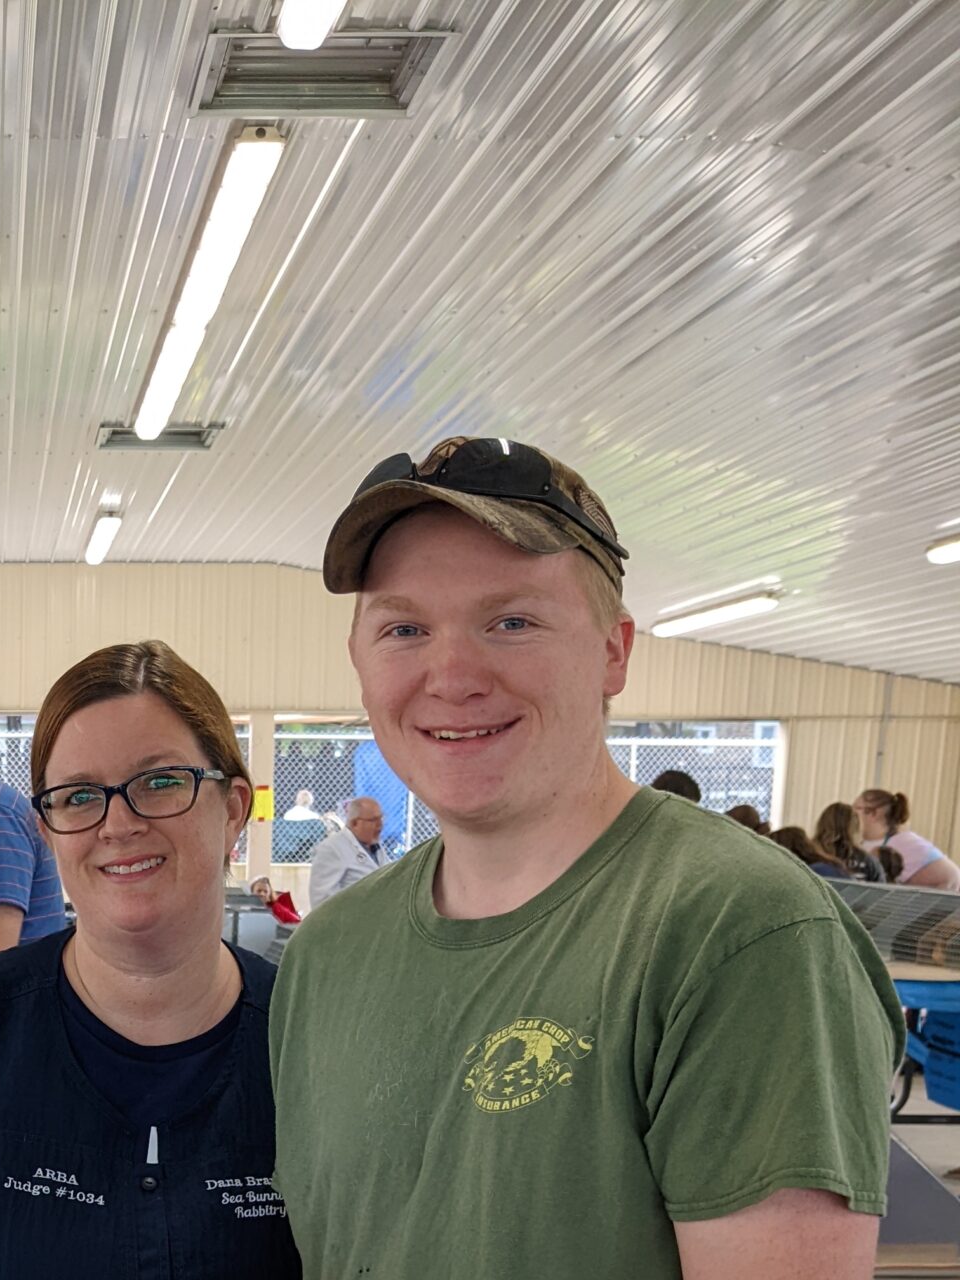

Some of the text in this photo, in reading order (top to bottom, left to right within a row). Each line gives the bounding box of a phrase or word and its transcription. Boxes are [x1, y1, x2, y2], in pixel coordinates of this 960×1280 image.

[542, 1022, 570, 1043] CROP
[475, 1089, 541, 1110] INSURANCE
[32, 1167, 79, 1186] ARBA
[205, 1176, 273, 1190] Dana Bra
[3, 1176, 105, 1206] Judge #1034
[221, 1191, 245, 1205] Sea
[234, 1205, 287, 1219] Rabbitry
